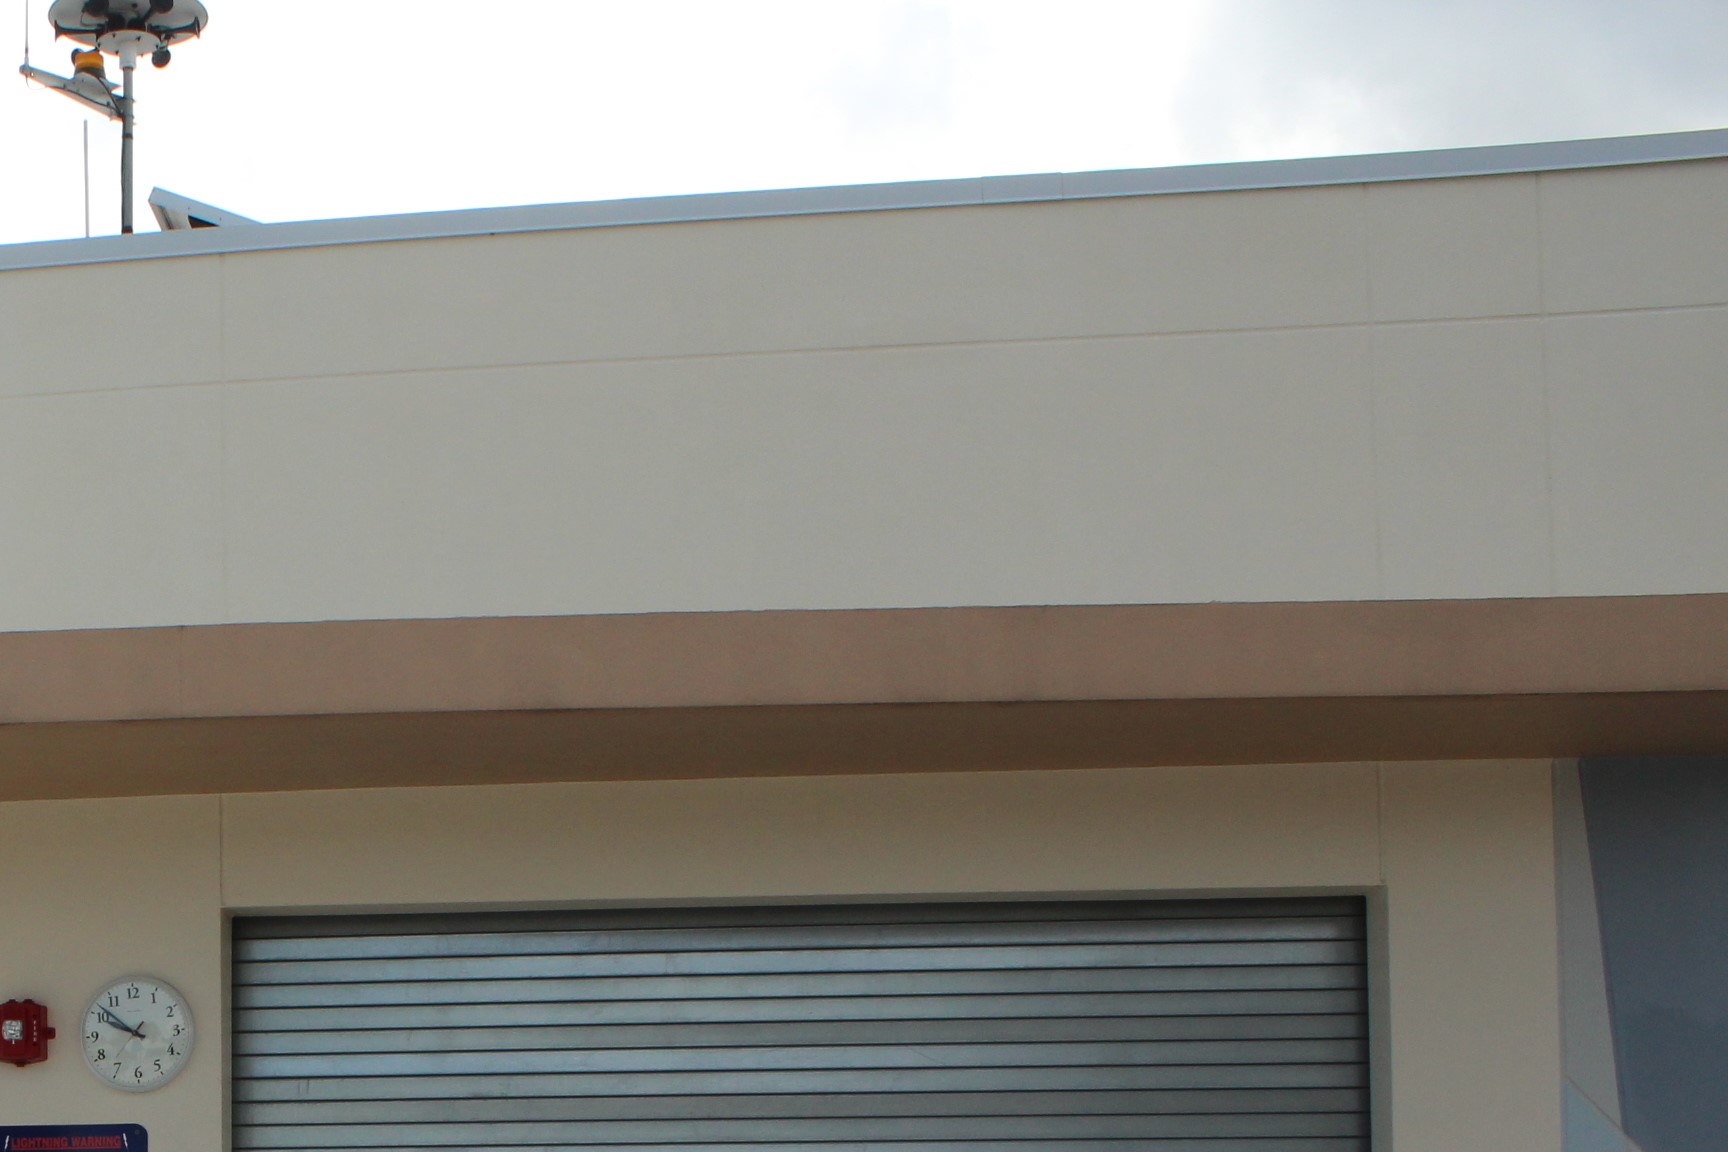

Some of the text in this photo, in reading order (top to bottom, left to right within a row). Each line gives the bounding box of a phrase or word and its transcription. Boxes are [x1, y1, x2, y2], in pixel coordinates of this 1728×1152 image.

[128, 988, 140, 999] 12
[151, 992, 156, 1003] 1
[108, 996, 119, 1007] 11
[167, 1006, 174, 1017] 2
[97, 1012, 109, 1023] 10
[173, 1025, 180, 1036] 3
[91, 1031, 99, 1043] 9
[98, 1049, 105, 1060] 8
[167, 1043, 175, 1055] 4
[114, 1062, 122, 1074] 7
[154, 1059, 161, 1071] 5
[135, 1066, 142, 1078] 6
[12, 1136, 121, 1149] LIGHTNING WARNING
